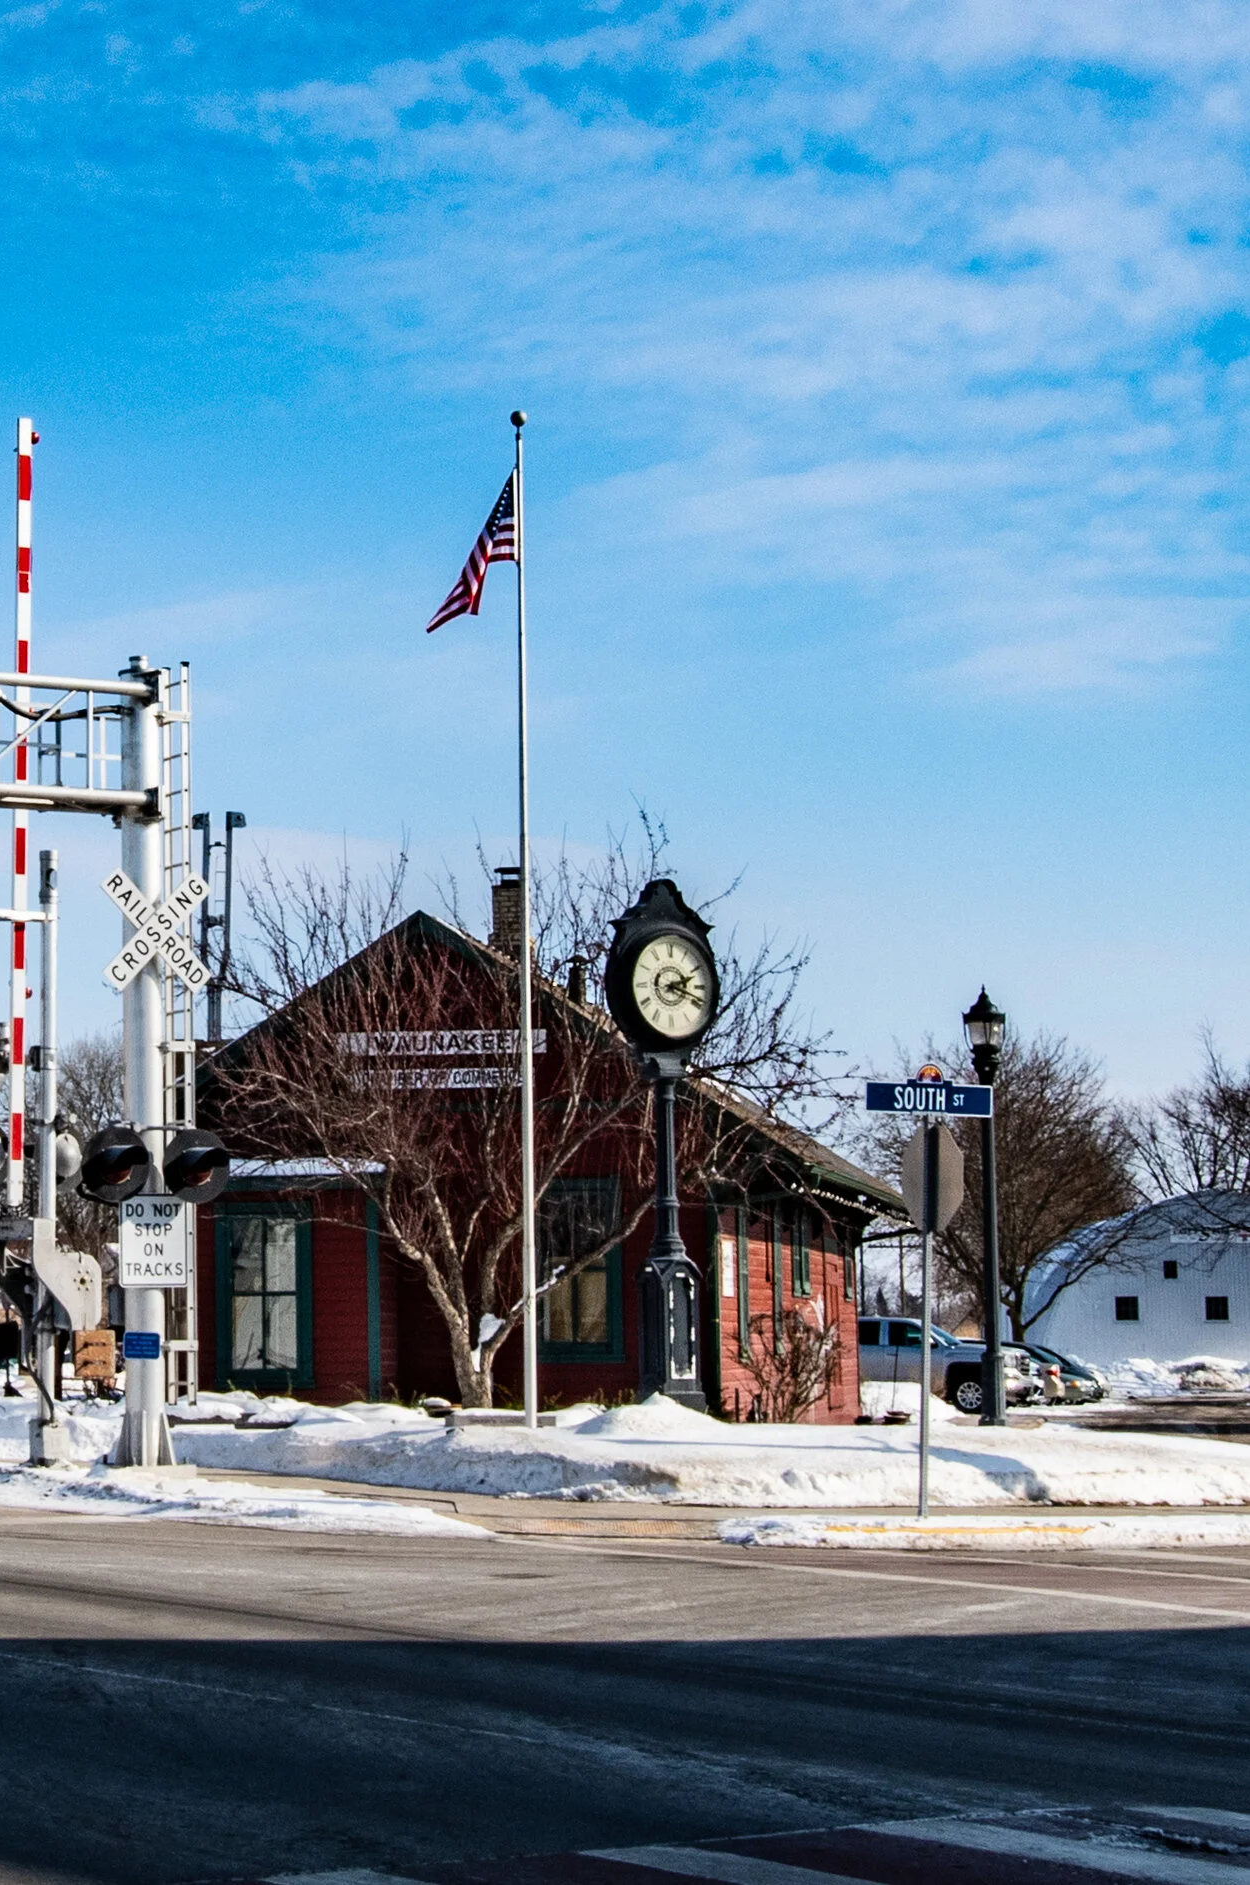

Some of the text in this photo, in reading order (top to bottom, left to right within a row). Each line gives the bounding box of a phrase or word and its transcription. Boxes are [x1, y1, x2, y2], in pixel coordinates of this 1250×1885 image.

[107, 874, 203, 984] RAIL ROAD
[111, 879, 203, 981] CROSSING
[374, 1033, 512, 1052] WAUNAKEE
[894, 1086, 965, 1110] SOUTH ST
[125, 1203, 181, 1217] DO NOT
[134, 1223, 172, 1237] STOP
[144, 1243, 164, 1256] ON
[125, 1262, 183, 1276] TRACKS
